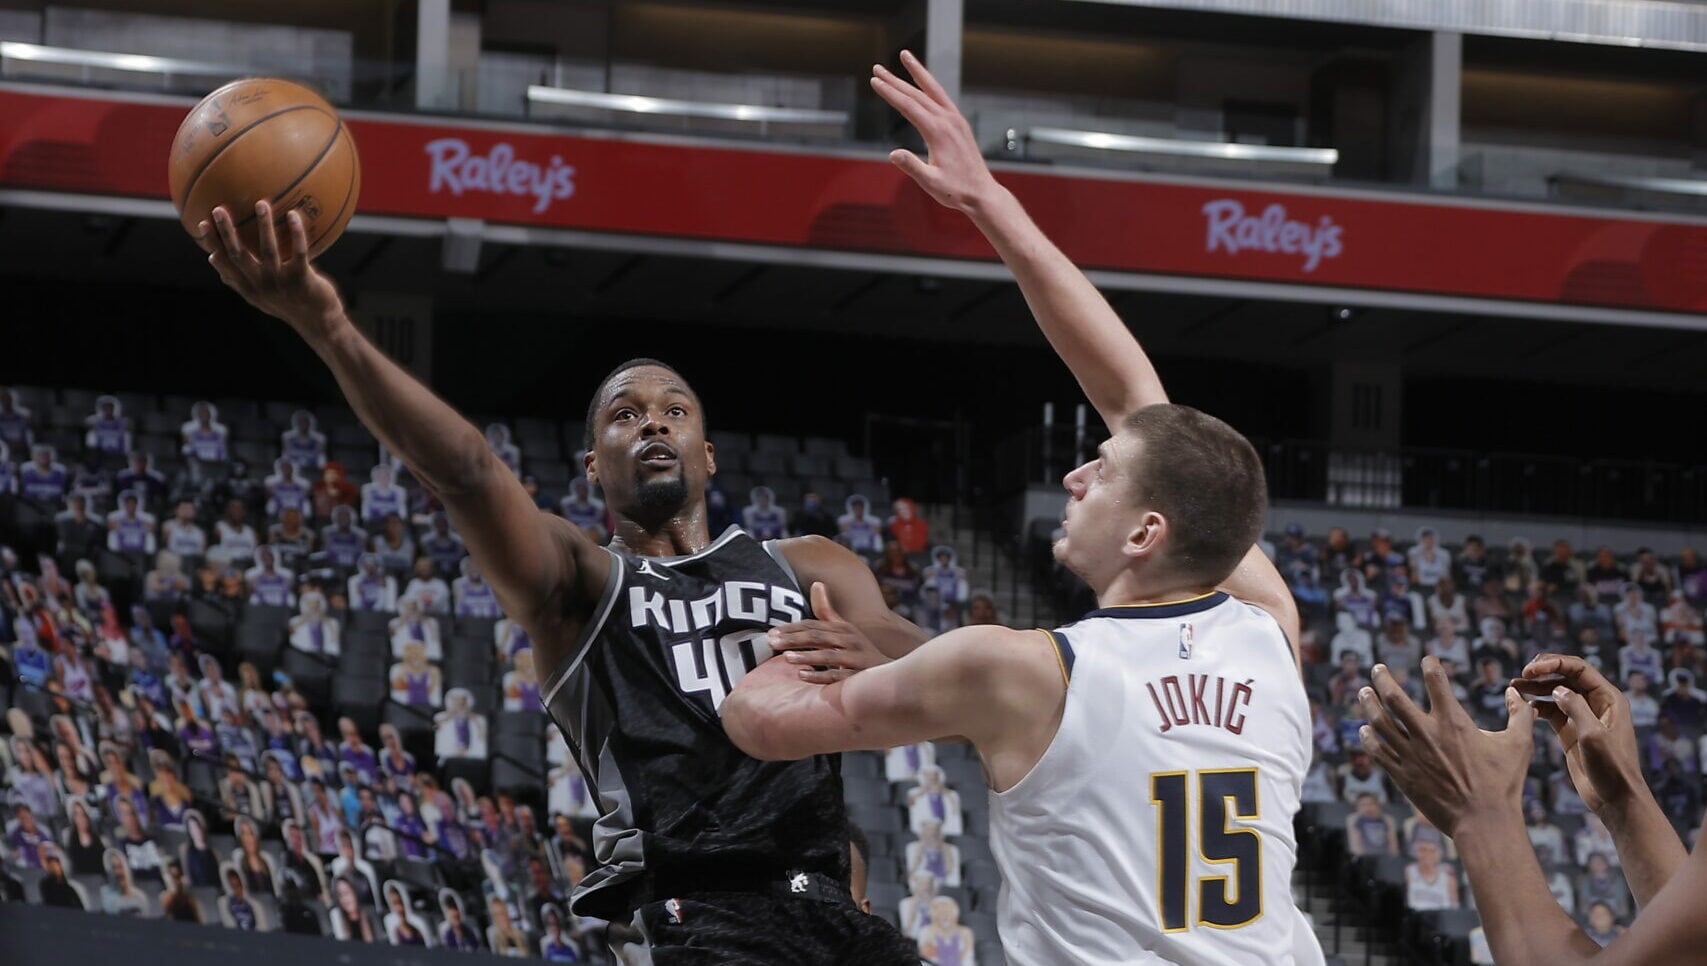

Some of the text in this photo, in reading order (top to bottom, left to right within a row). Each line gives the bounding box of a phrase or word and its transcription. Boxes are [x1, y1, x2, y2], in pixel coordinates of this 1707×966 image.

[425, 138, 575, 214] Raley's
[1202, 199, 1343, 273] Raley's
[629, 581, 804, 633] KINGS
[1146, 674, 1255, 736] JOKIĆ
[1149, 767, 1264, 934] 15
